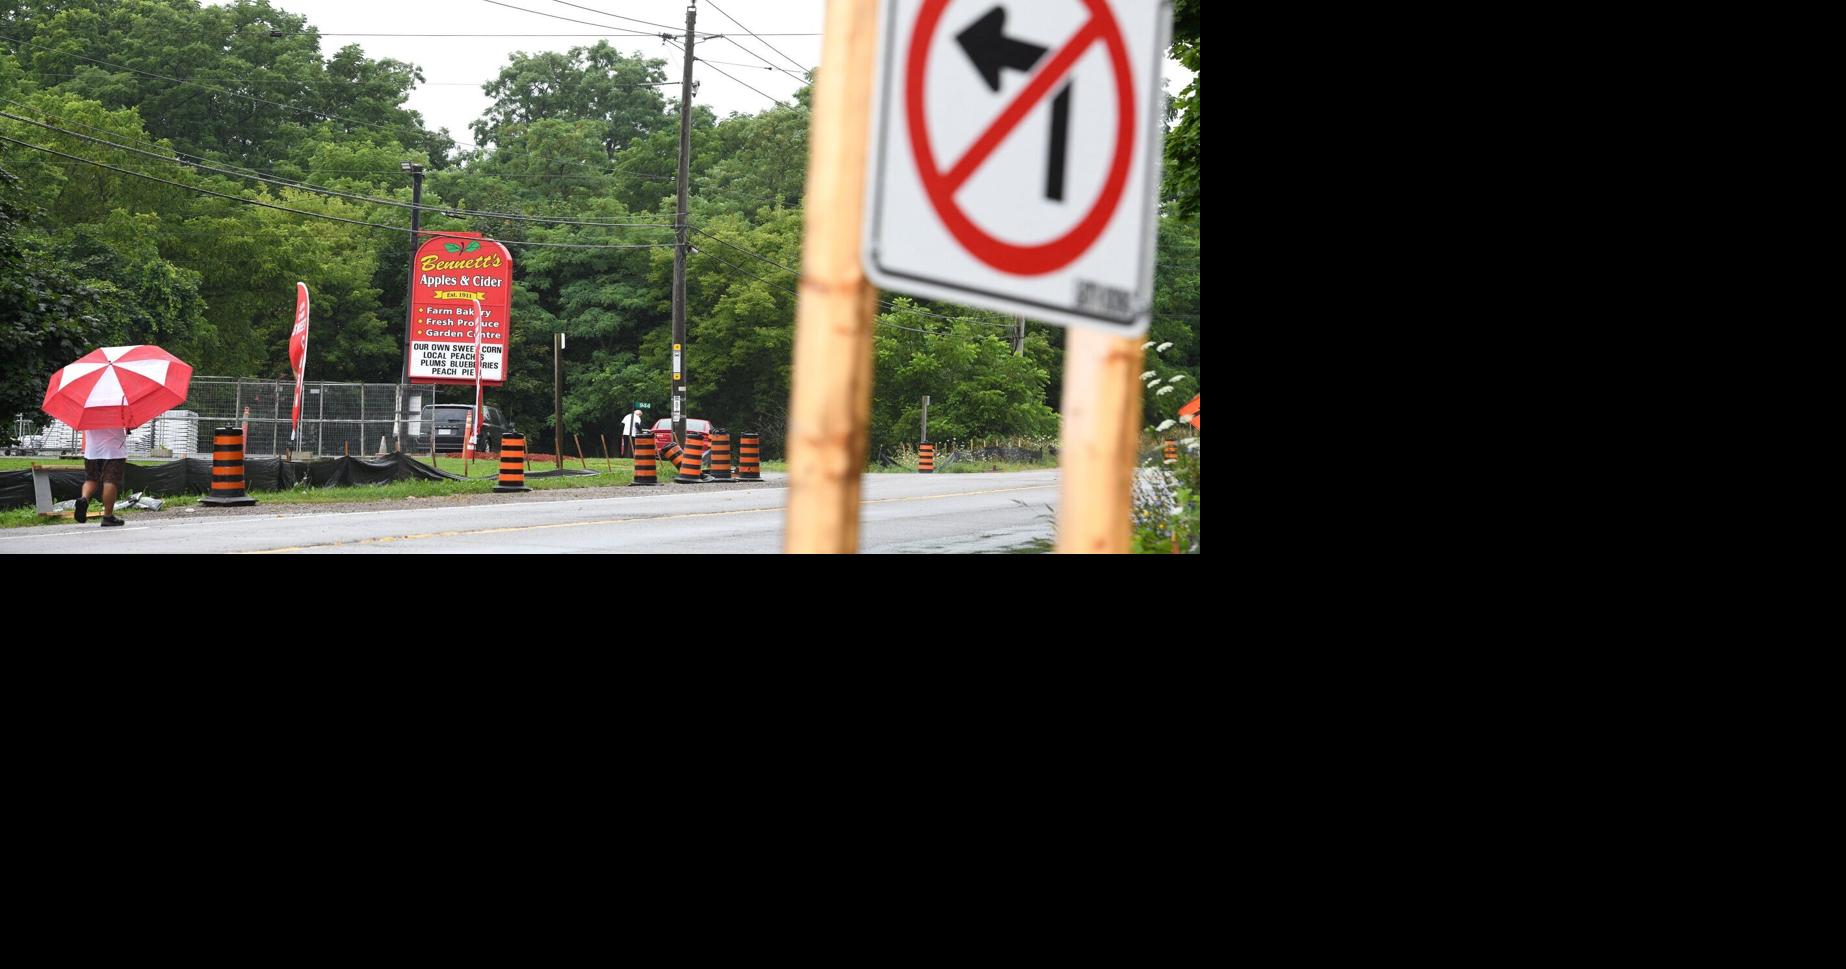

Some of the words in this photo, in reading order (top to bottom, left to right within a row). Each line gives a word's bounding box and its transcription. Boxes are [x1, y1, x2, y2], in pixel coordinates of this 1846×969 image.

[420, 253, 502, 272] Bennett's
[420, 274, 457, 288] Apples
[460, 275, 470, 286] &
[472, 275, 502, 287] Cider
[426, 307, 453, 315] Farm
[456, 307, 491, 317] Bakry
[426, 318, 454, 326] Fresh
[457, 319, 499, 328] Prouce
[425, 329, 463, 337] Garden
[413, 343, 429, 351] OUR
[431, 343, 450, 352] OWN
[452, 344, 475, 353] SWEE
[481, 345, 502, 354] CORN
[423, 351, 447, 360] LOCAL
[450, 352, 485, 361] PEACHS
[420, 359, 446, 367] PLUMS
[431, 367, 457, 376] PEACH
[461, 368, 482, 377] PIE
